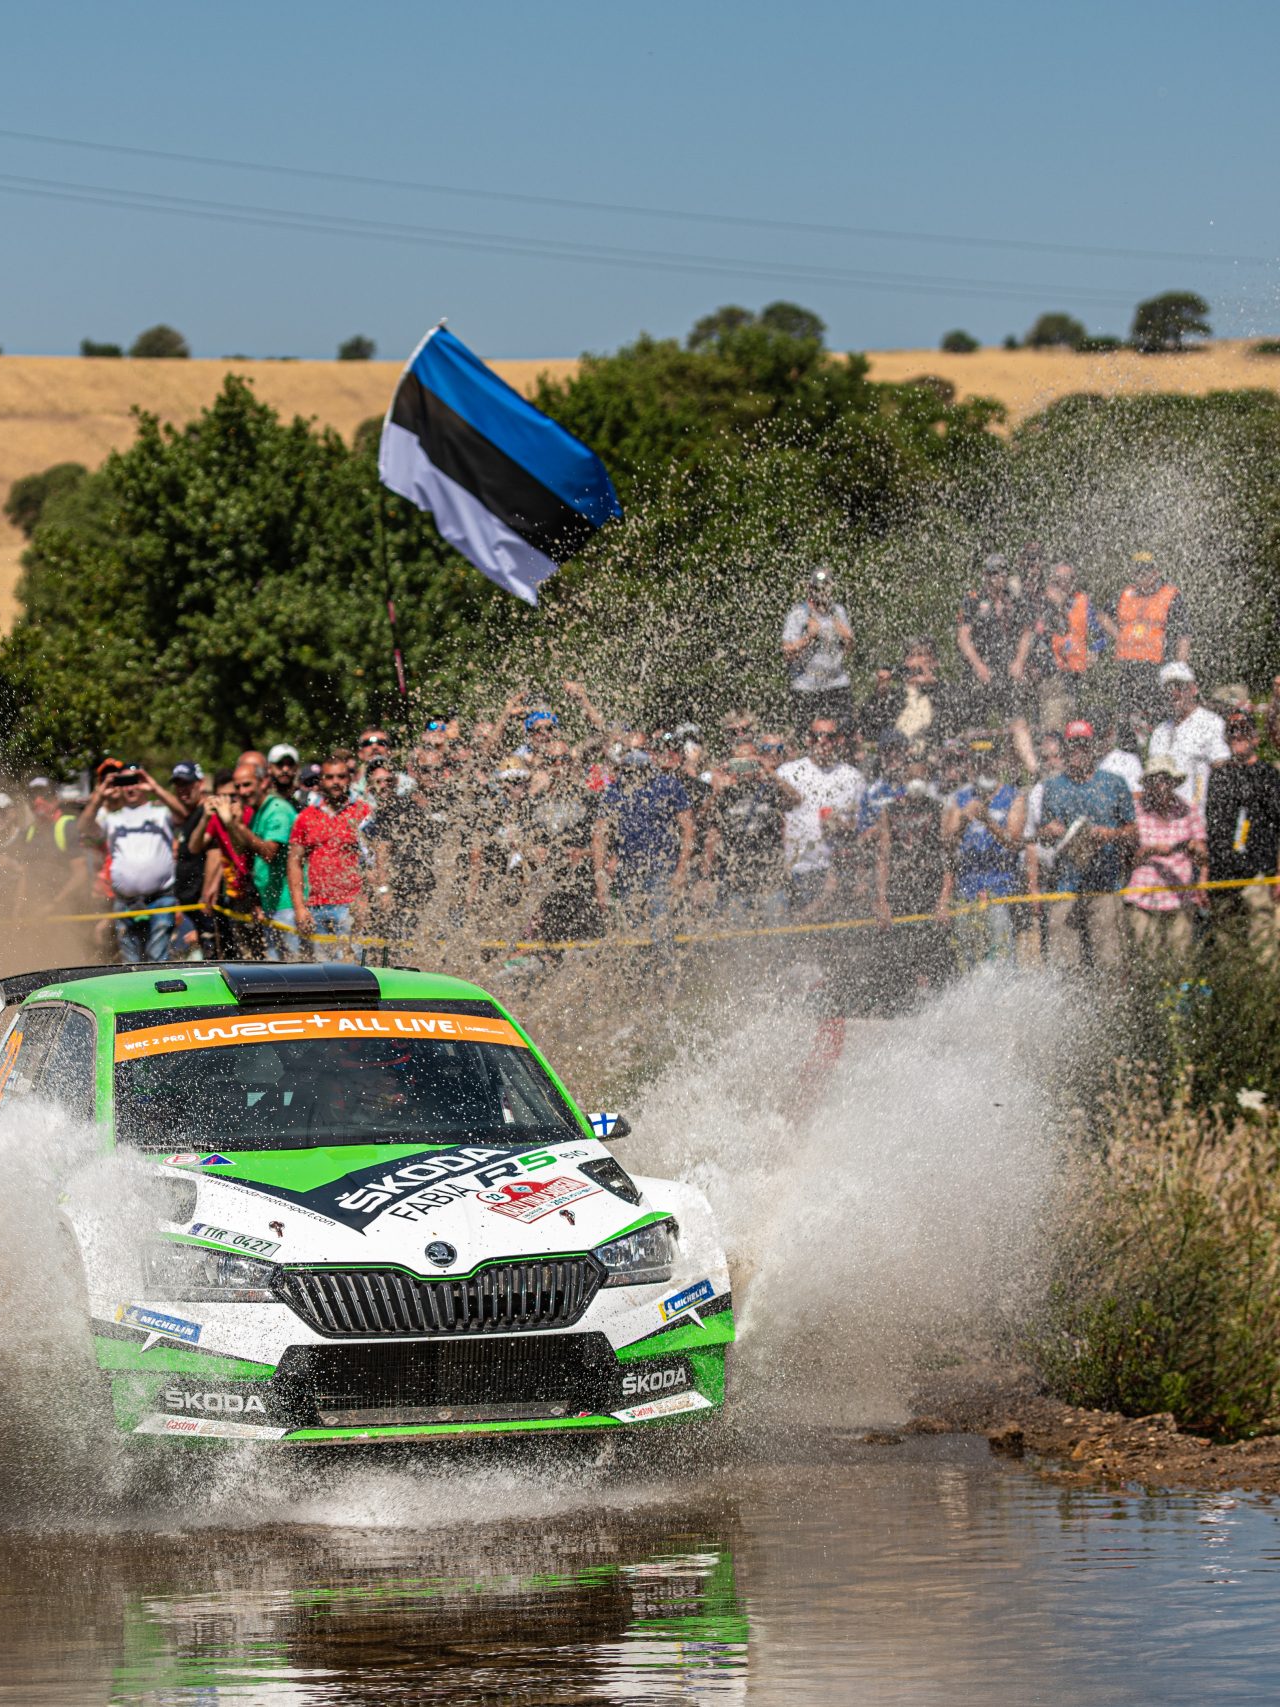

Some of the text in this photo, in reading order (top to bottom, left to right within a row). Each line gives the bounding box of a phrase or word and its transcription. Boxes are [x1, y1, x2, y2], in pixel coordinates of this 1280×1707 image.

[338, 1018, 390, 1032] ALL
[394, 1018, 457, 1034] LIVE
[334, 1147, 511, 1213] ŠKODA
[388, 1182, 479, 1222] FABIA
[473, 1150, 558, 1188] R5
[232, 1235, 273, 1252] 0427
[674, 1285, 708, 1310] MICHELIN
[140, 1315, 195, 1336] MICHELIN
[622, 1367, 687, 1396] ŠKODA
[165, 1386, 267, 1413] ŠKODA
[166, 1419, 199, 1431] Castrol
